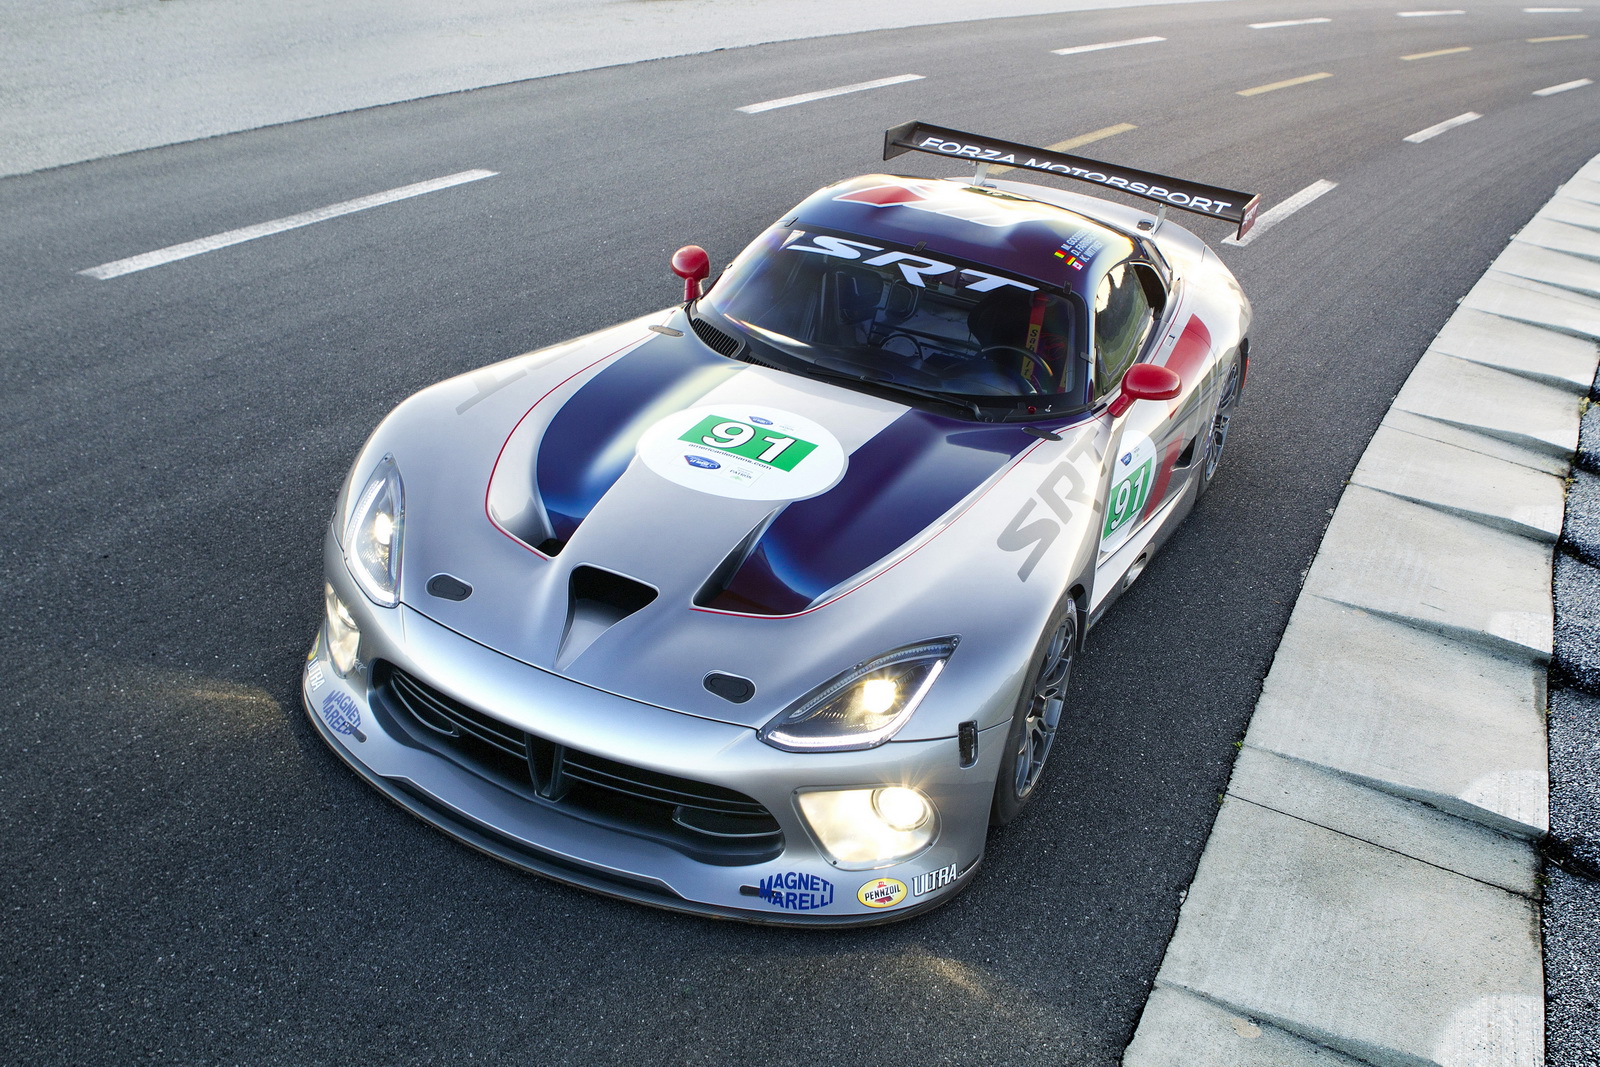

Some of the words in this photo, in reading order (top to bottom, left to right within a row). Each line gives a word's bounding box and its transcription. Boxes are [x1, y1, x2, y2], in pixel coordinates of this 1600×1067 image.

[919, 136, 1015, 164] FORZA
[1024, 158, 1233, 214] MOTORSPORT
[786, 235, 1040, 293] SRT
[1023, 329, 1039, 376] Sablt
[701, 421, 798, 464] 91
[996, 426, 1107, 583] SRT
[1109, 464, 1147, 532] 91
[307, 657, 326, 692] ULTRA
[322, 689, 362, 728] MAGNETI
[759, 871, 834, 894] MAGNETI
[759, 888, 834, 911] MARELLI
[864, 883, 902, 902] PENNZOIL
[911, 863, 958, 898] ULTRA
